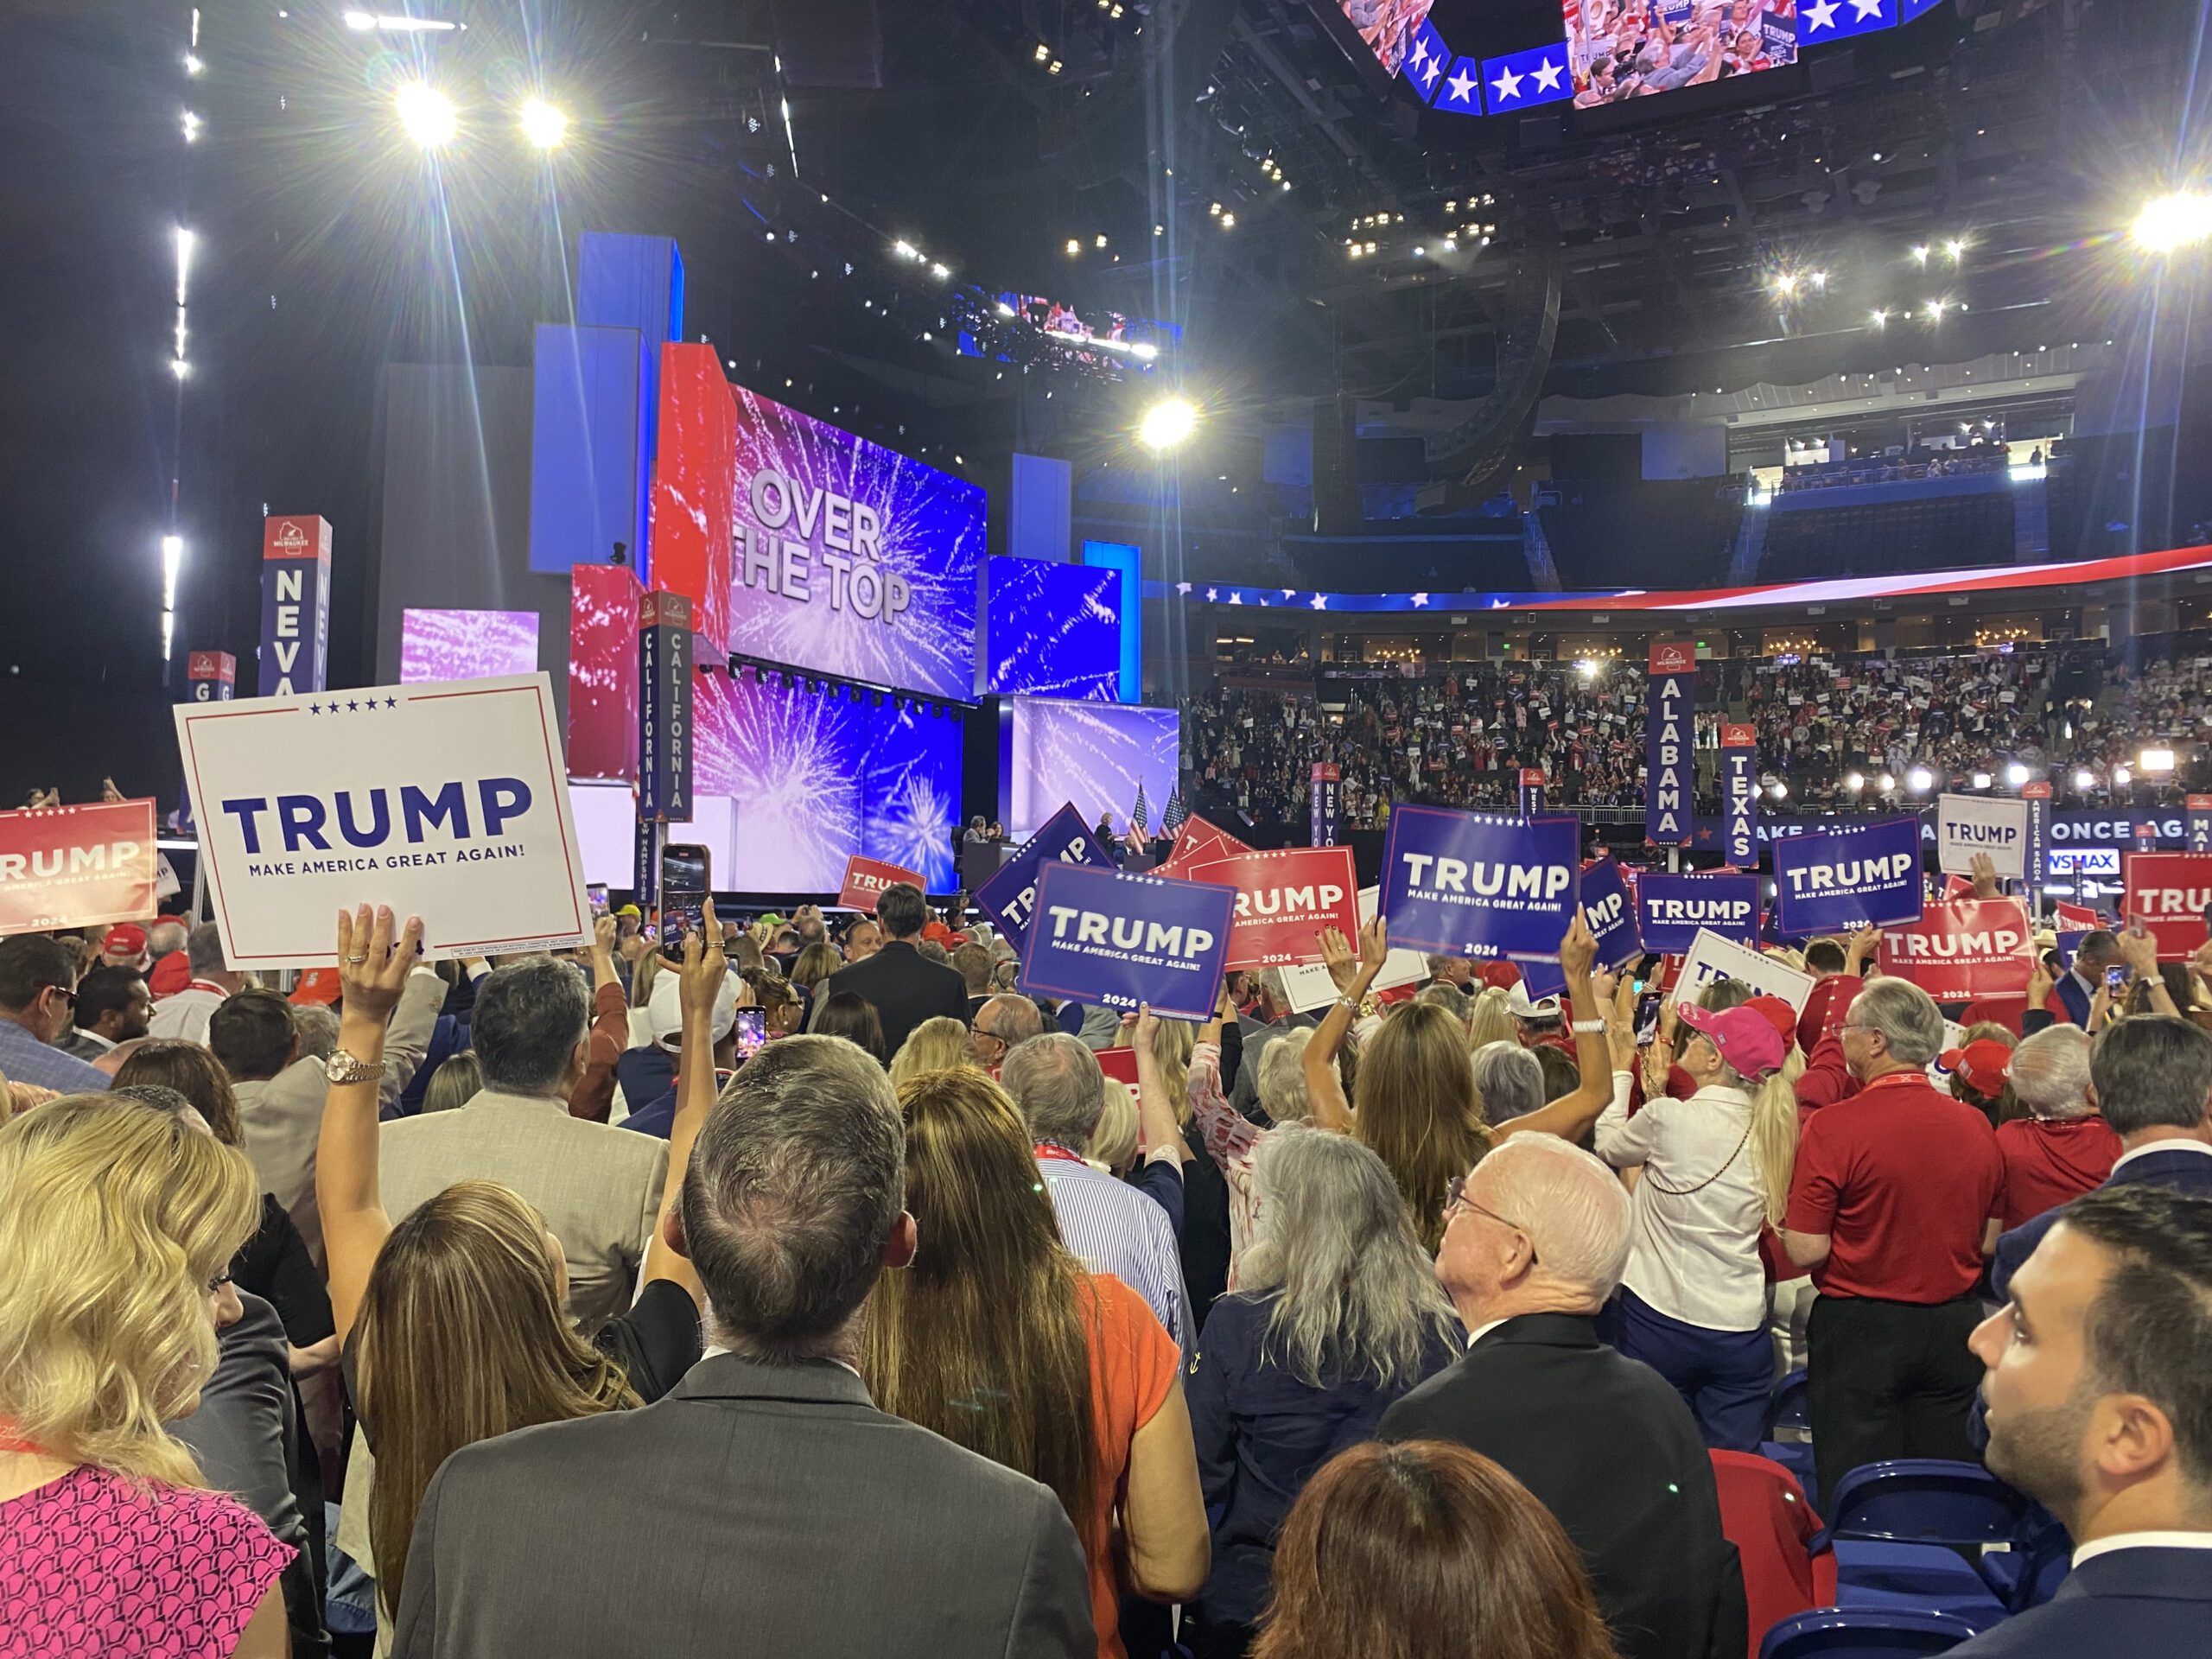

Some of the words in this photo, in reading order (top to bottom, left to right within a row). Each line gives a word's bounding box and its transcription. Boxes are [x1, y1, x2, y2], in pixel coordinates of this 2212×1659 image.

[1763, 24, 1796, 43] TRUMP
[1580, 51, 1611, 62] TUMP
[751, 469, 881, 562] OVER
[823, 553, 911, 625] TOP
[315, 574, 327, 691] NEV
[671, 633, 683, 808] CALIFORNIA
[1658, 678, 1681, 832] ALABAMA
[1325, 784, 1334, 818] NEW
[1731, 756, 1751, 855] TEXAS
[221, 778, 532, 854] TRUMP
[2032, 800, 2041, 849] AMERICAN
[1757, 825, 1803, 842] AKE
[2050, 822, 2131, 840] ONCE
[1947, 823, 2017, 843] TRUMP
[0, 842, 140, 881] RUMP
[249, 862, 296, 876] MAKE
[302, 858, 379, 874] AMERICA
[386, 852, 448, 868] GREAT
[455, 844, 525, 862] AGAIN!
[1787, 854, 1911, 891] TRUMP
[3, 879, 52, 892] AMERICA
[54, 875, 91, 886] GREAT
[94, 870, 130, 880] AGAIN!
[852, 872, 899, 891] TRU
[1403, 853, 1570, 899] TRUMP
[1408, 889, 1438, 901] MAKE
[1441, 893, 1490, 907] AMERICA
[1492, 899, 1525, 910] GREAT
[1527, 901, 1561, 912] AGAIN!
[1795, 892, 1816, 900] MAKE
[1819, 889, 1855, 898] AMERICA
[1857, 885, 1881, 893] GREAT
[1883, 880, 1907, 889] AGAIN!
[31, 916, 68, 927] 2024
[1235, 918, 1274, 928] AMERICA
[1276, 914, 1304, 923] GREAT
[1307, 912, 1338, 921] AGAIN!
[1647, 899, 1751, 919] TRUMP
[1049, 906, 1214, 958] TRUMP
[1884, 931, 2018, 957] TRUMP
[1052, 939, 1081, 953] MAKE
[1082, 945, 1128, 960] AMERICA
[1131, 954, 1164, 966] GREAT
[1166, 960, 1200, 971] AGAIN!
[1262, 954, 1292, 963] 2024
[1464, 943, 1498, 957] 2024
[1300, 966, 1319, 976] MAKE
[1103, 994, 1137, 1008] 2024
